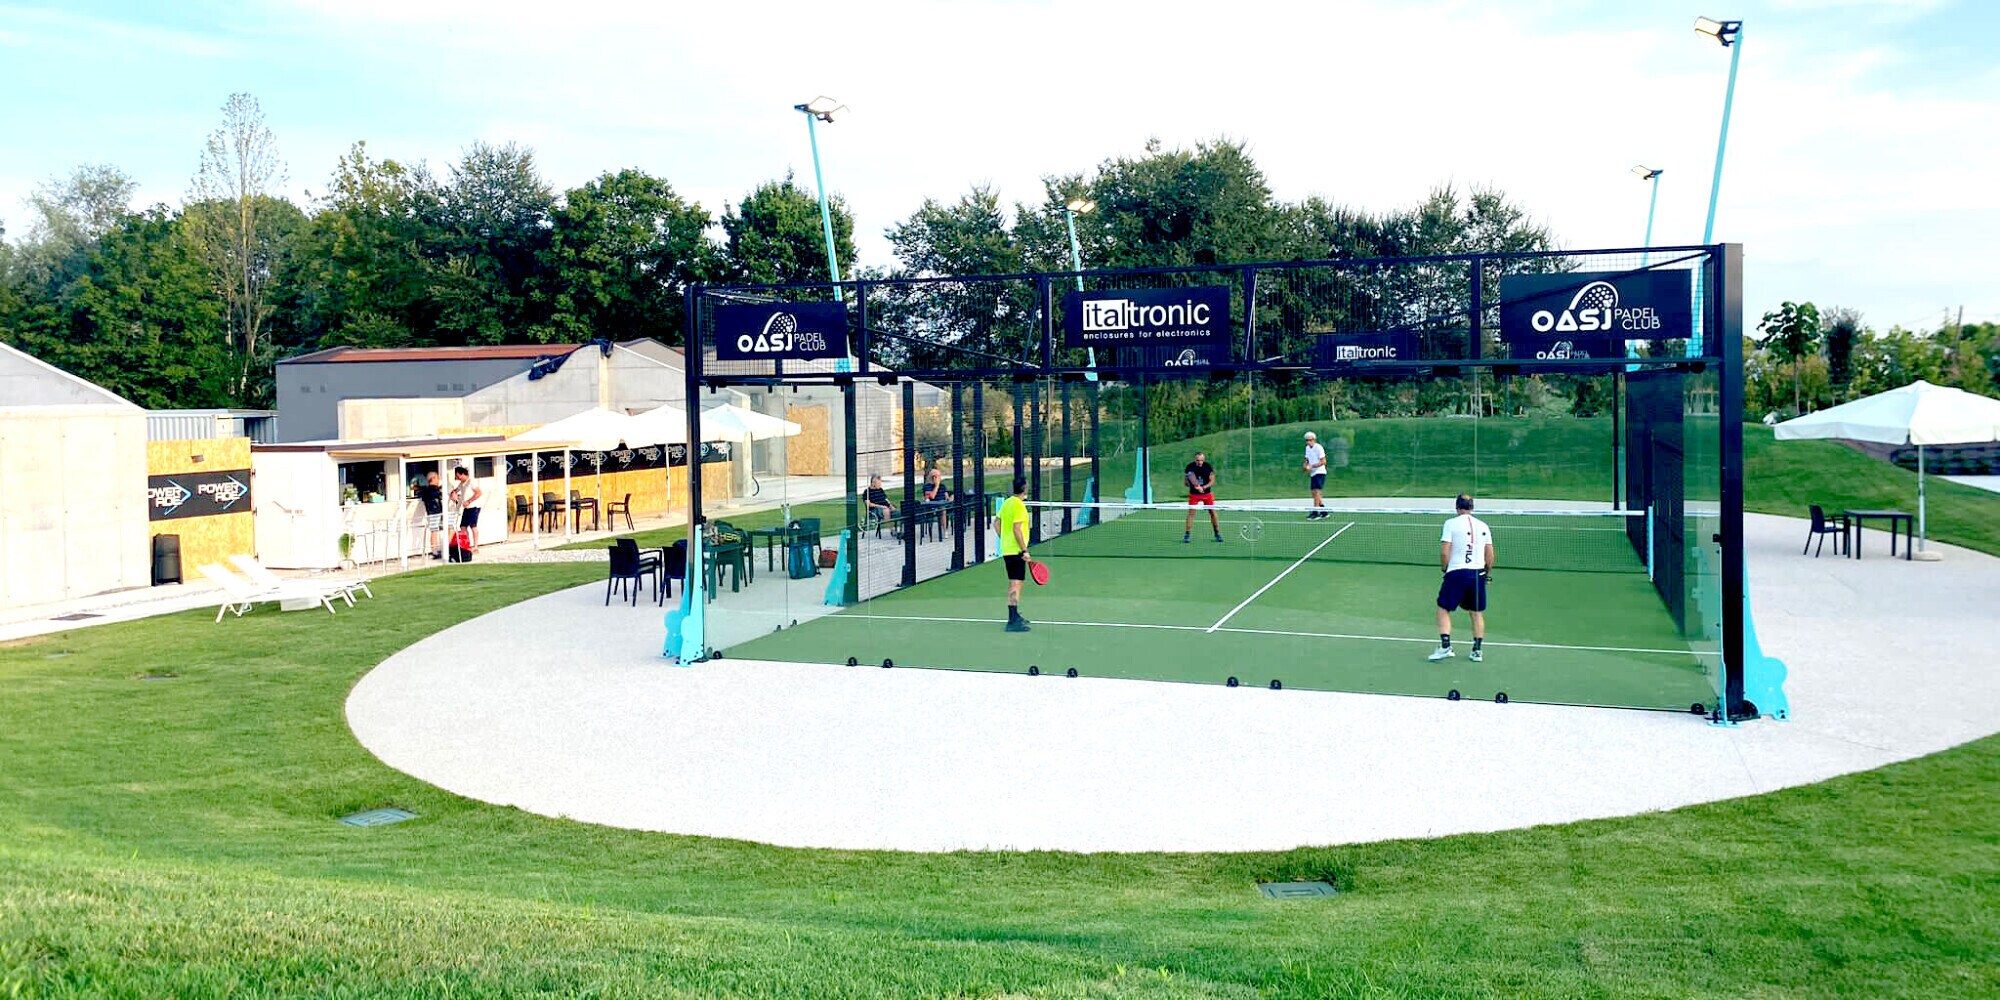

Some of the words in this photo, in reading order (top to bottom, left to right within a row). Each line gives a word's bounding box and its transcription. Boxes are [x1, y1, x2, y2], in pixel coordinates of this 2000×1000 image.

[1083, 299, 1210, 330] italtronic
[1614, 307, 1656, 319] PADEL
[1622, 316, 1661, 329] CLUB
[794, 333, 825, 343] PADEL
[1083, 331, 1135, 340] enclosures
[1139, 330, 1152, 338] for
[1156, 329, 1211, 338] electronics
[800, 341, 826, 351] CLUB
[1336, 345, 1397, 360] italtronic
[148, 486, 182, 498] OWER
[197, 482, 239, 494] POWER
[1465, 544, 1473, 564] FILA
